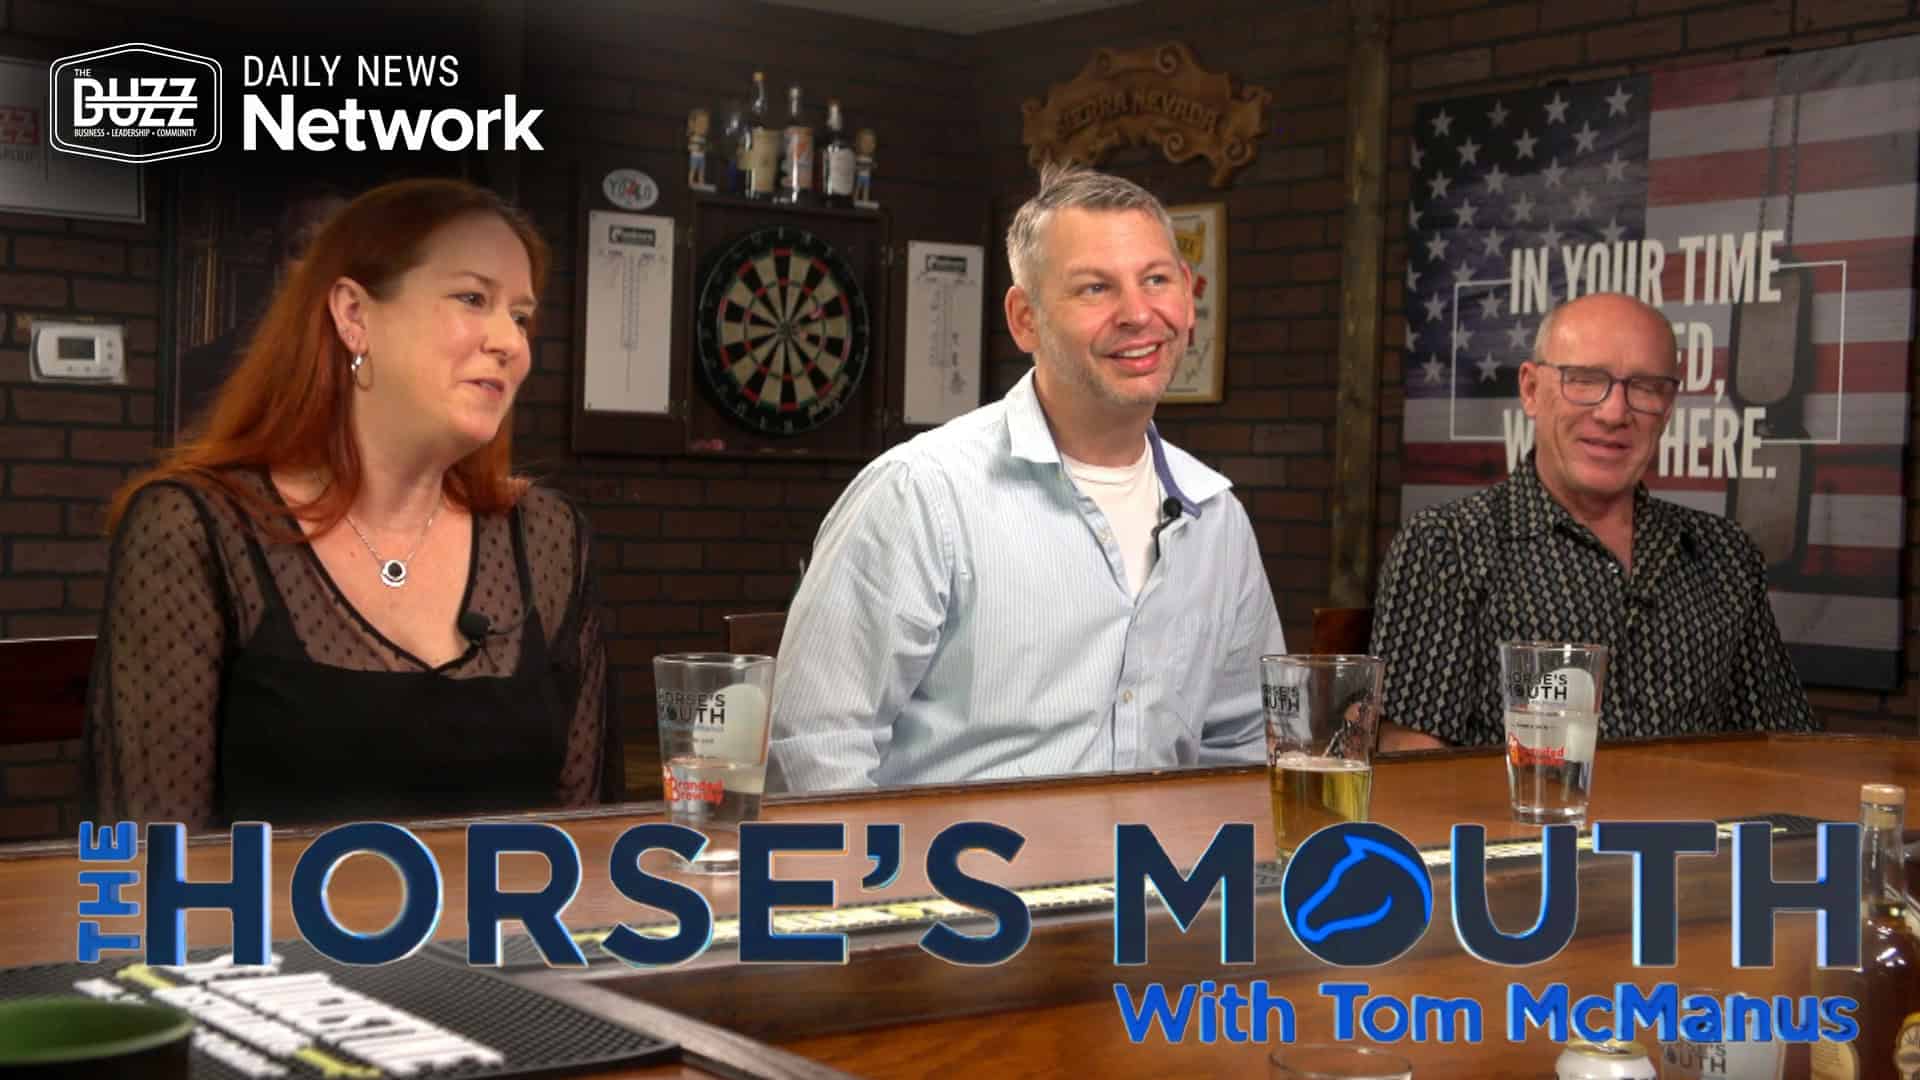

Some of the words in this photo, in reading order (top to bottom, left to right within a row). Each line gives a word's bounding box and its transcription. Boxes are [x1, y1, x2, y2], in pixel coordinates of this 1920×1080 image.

[1509, 246, 1549, 316] IN
[1561, 238, 1666, 308] YOUR
[1678, 229, 1785, 306] TIME
[1657, 406, 1778, 479] HERE.
